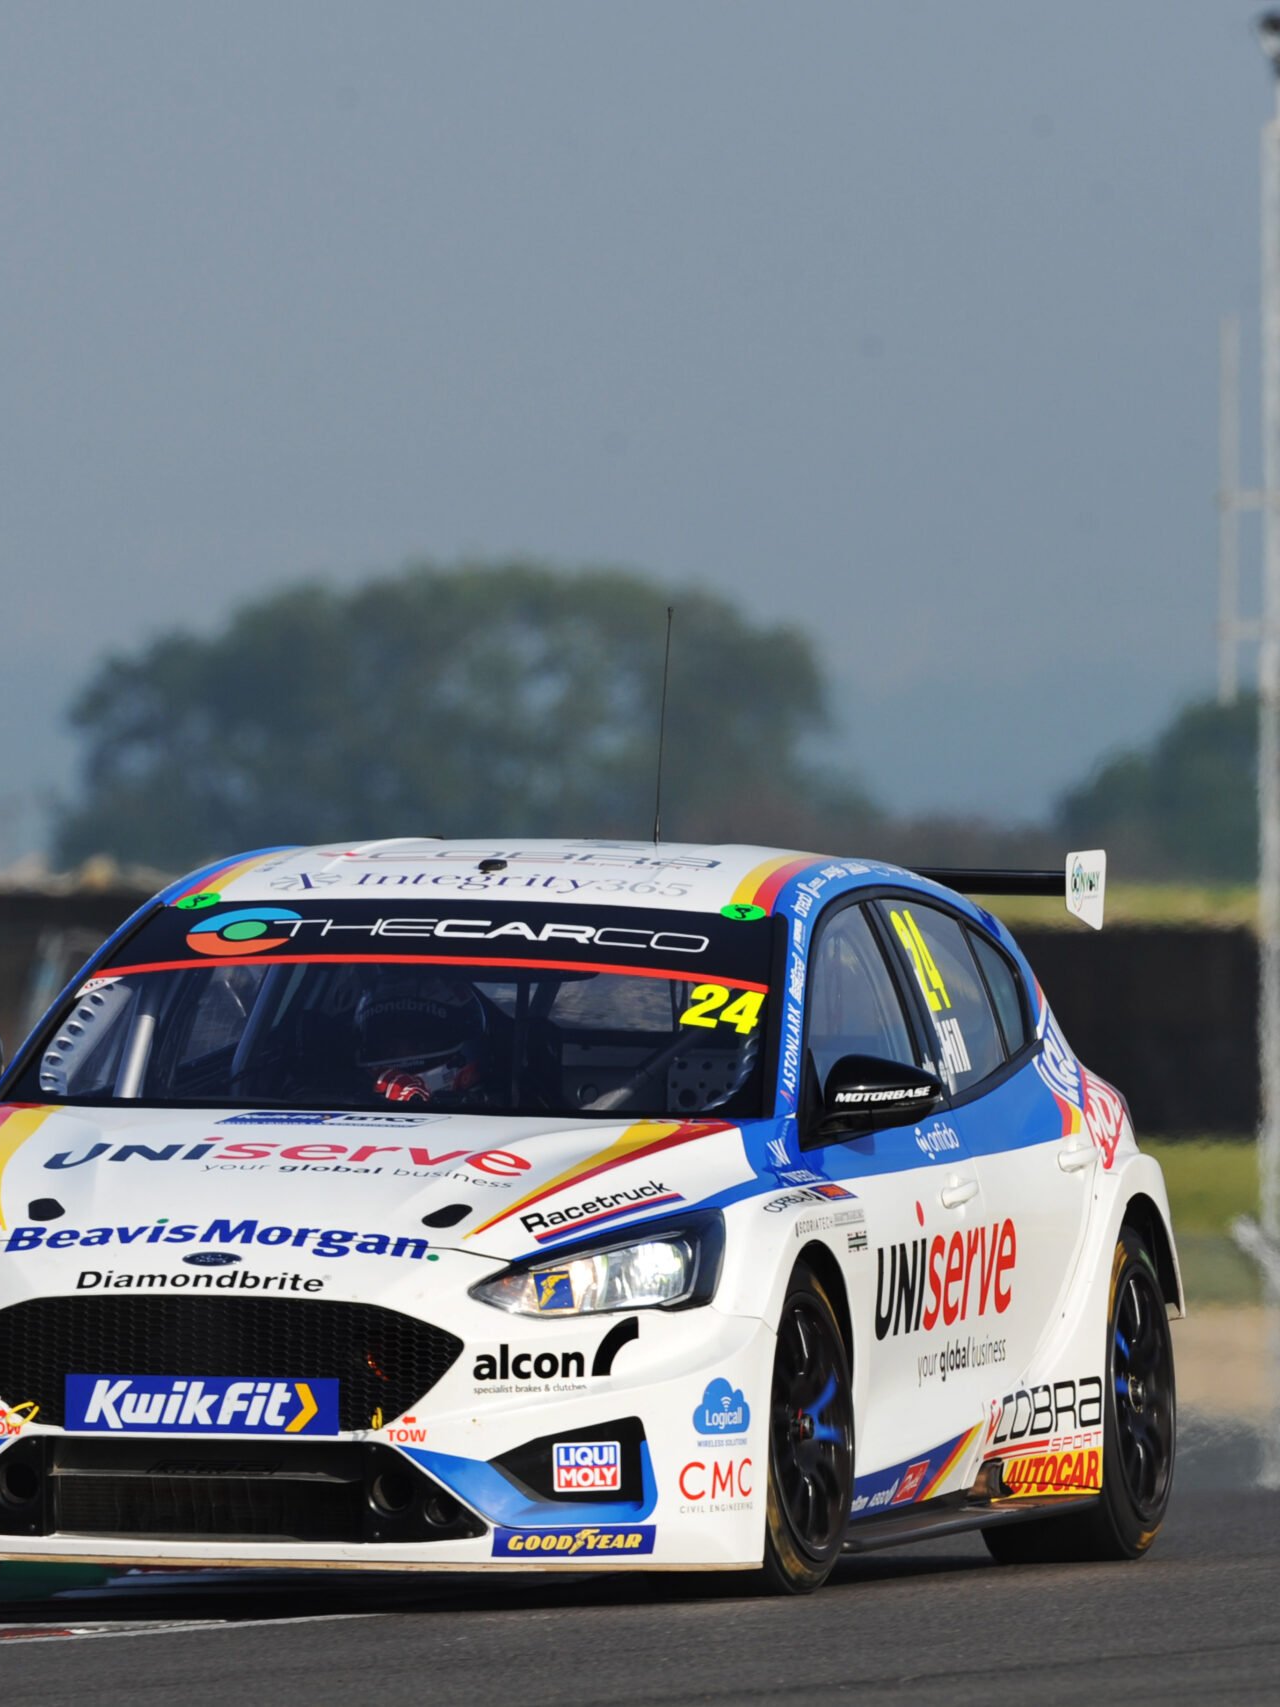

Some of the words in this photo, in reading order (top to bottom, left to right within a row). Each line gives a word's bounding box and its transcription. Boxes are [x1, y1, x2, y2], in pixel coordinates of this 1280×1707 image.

[357, 872, 694, 898] Integrity365
[273, 918, 710, 954] THECARCO
[679, 984, 766, 1035] 24
[782, 1003, 802, 1094] ASTONLARK
[834, 1085, 932, 1103] MOTORBASE
[278, 1163, 383, 1175] global
[392, 1166, 513, 1189] business
[519, 1180, 673, 1234] Racetruck
[75, 1270, 325, 1293] Diamondbrite
[473, 1343, 585, 1381] alcon
[939, 1336, 971, 1382] global
[971, 1334, 1007, 1368] business
[473, 1384, 513, 1395] specialist
[515, 1384, 542, 1393] brakes
[544, 1384, 551, 1392] &
[705, 1406, 743, 1430] Logicall
[387, 1429, 427, 1442] TOW
[1049, 1431, 1102, 1451] SPORT
[558, 1446, 615, 1467] LIQUI
[558, 1467, 617, 1487] MOLY
[679, 1458, 753, 1501] CMC
[1005, 1450, 1100, 1495] AUTOCAR
[680, 1504, 705, 1514] CIVIL
